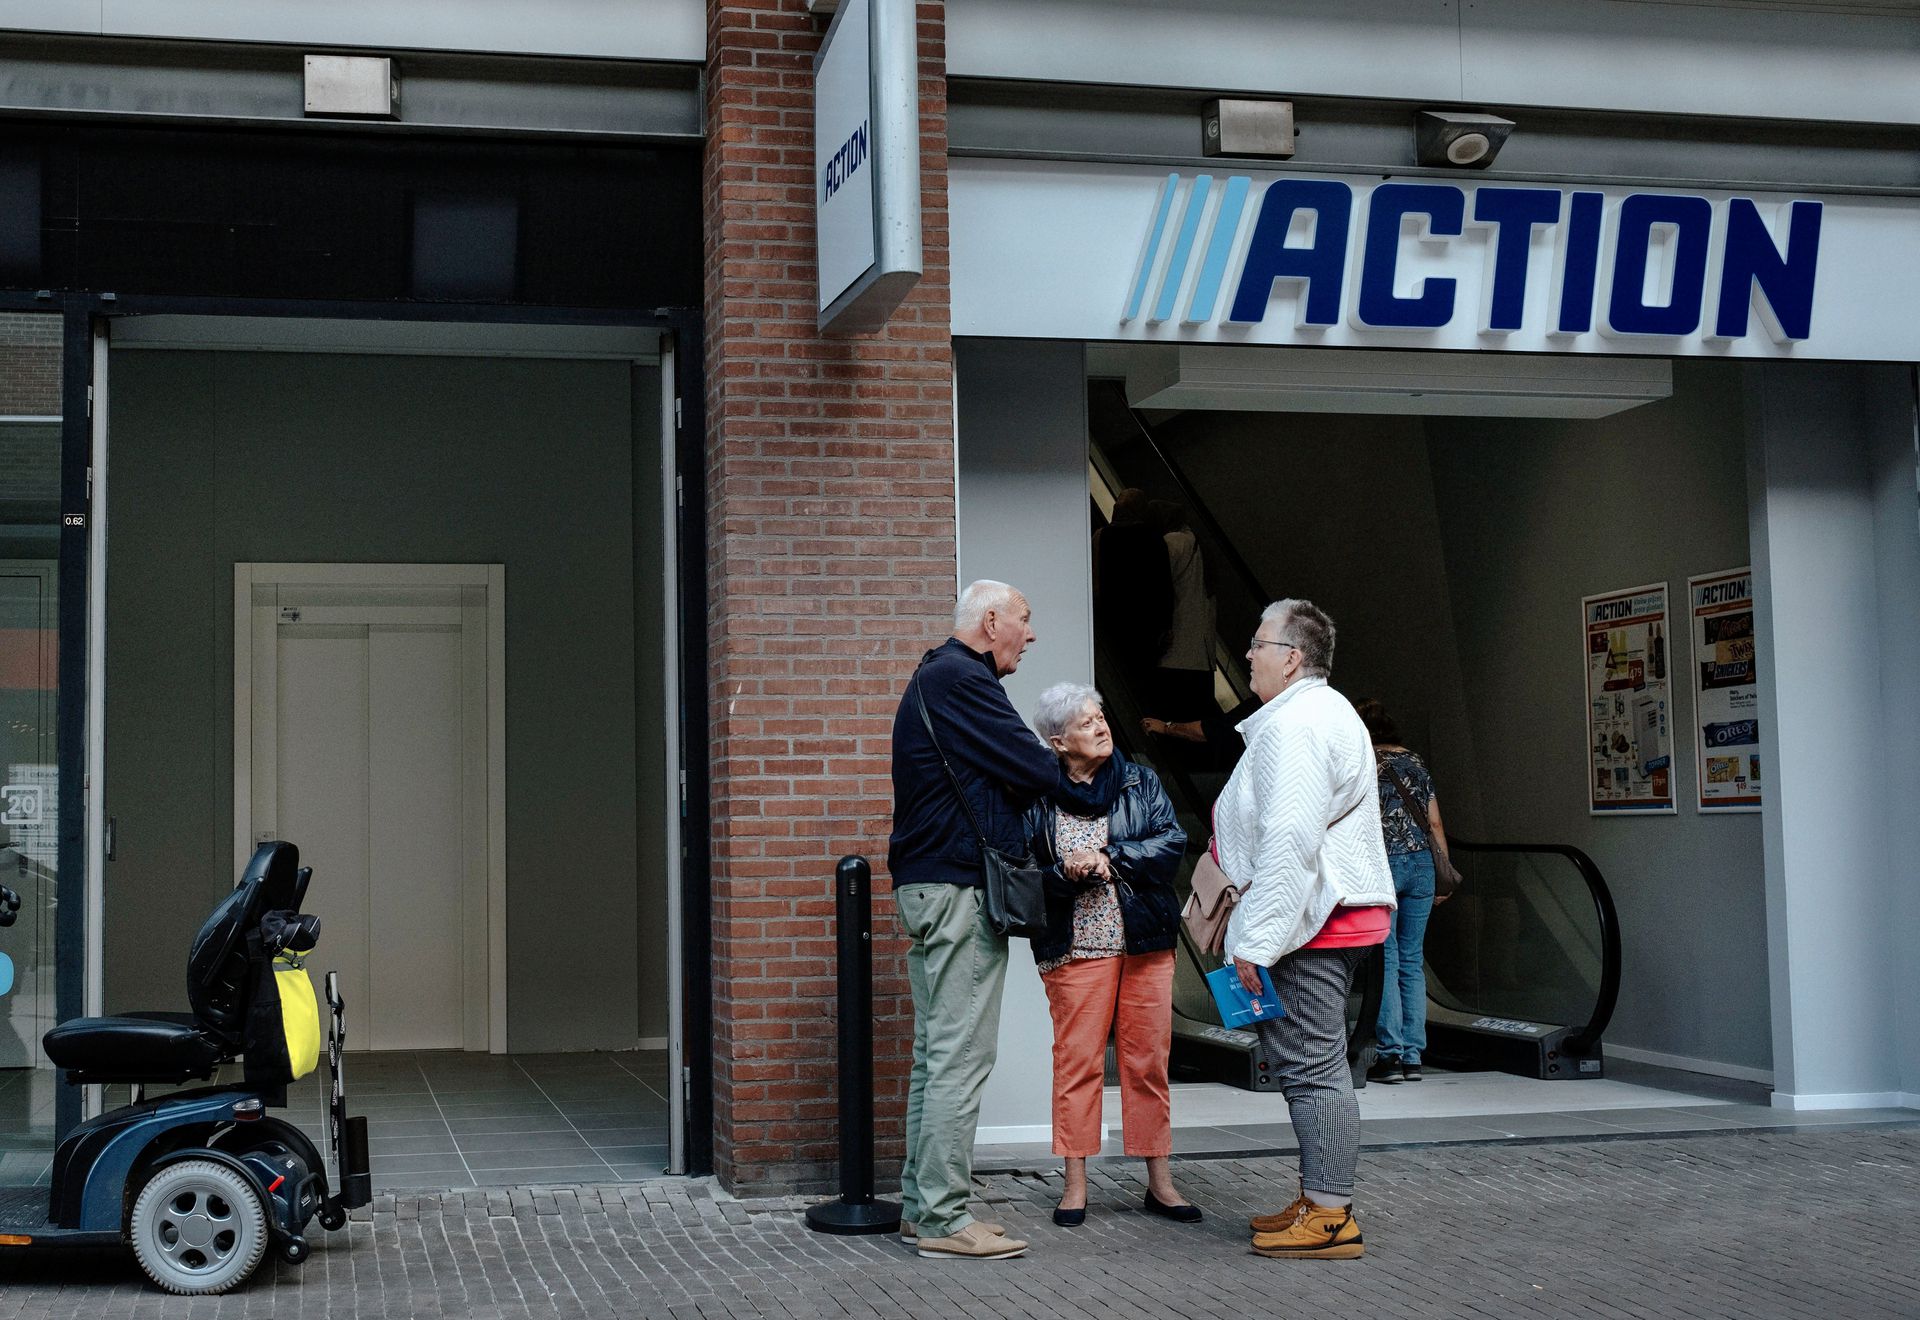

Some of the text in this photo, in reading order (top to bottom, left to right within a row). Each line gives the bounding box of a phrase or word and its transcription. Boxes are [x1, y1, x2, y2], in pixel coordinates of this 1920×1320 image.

[825, 119, 867, 204] ACTION
[1230, 179, 1823, 340] ACTION
[65, 517, 84, 527] 0.62
[1702, 580, 1745, 604] ACTION
[1595, 599, 1632, 621] ACTION
[1715, 662, 1747, 678] SNICKERS
[1716, 725, 1749, 743] OREO
[8, 796, 36, 815] 20
